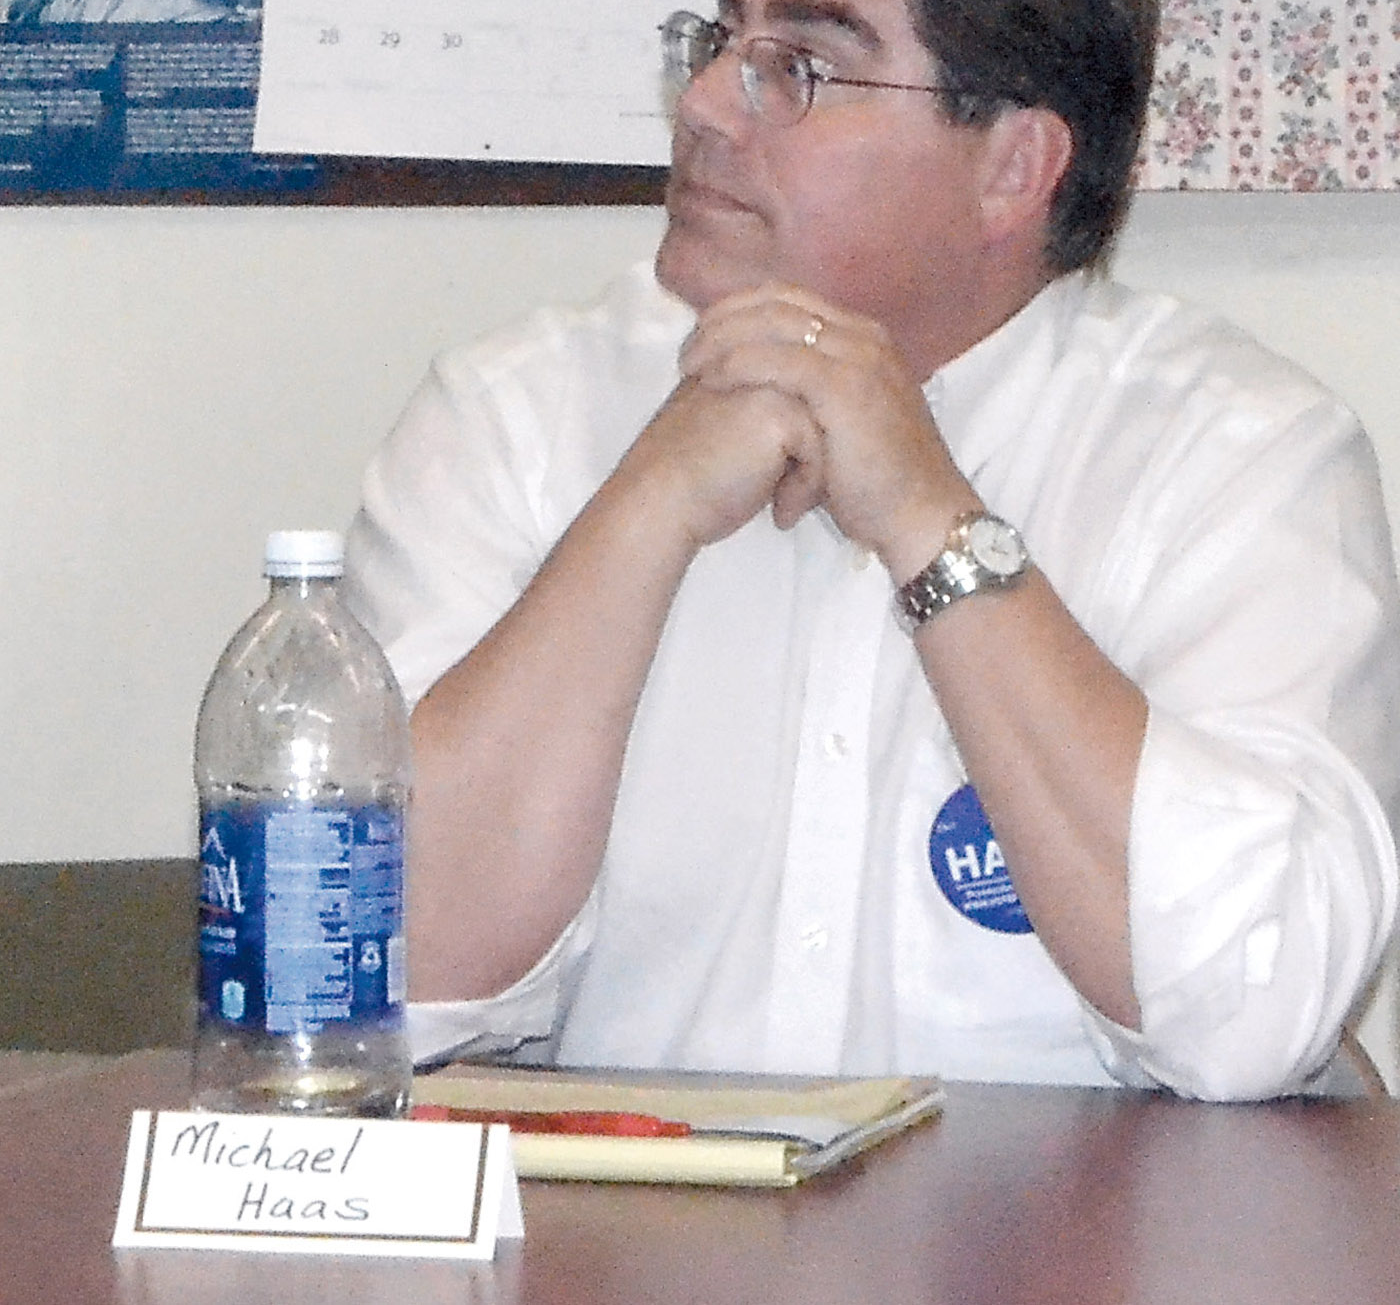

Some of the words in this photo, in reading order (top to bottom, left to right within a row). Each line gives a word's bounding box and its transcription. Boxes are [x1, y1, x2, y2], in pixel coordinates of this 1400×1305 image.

[318, 27, 340, 45] 28
[380, 31, 401, 49] 29
[442, 32, 463, 50] 30
[171, 1120, 363, 1175] Michael
[237, 1181, 369, 1222] Haas
